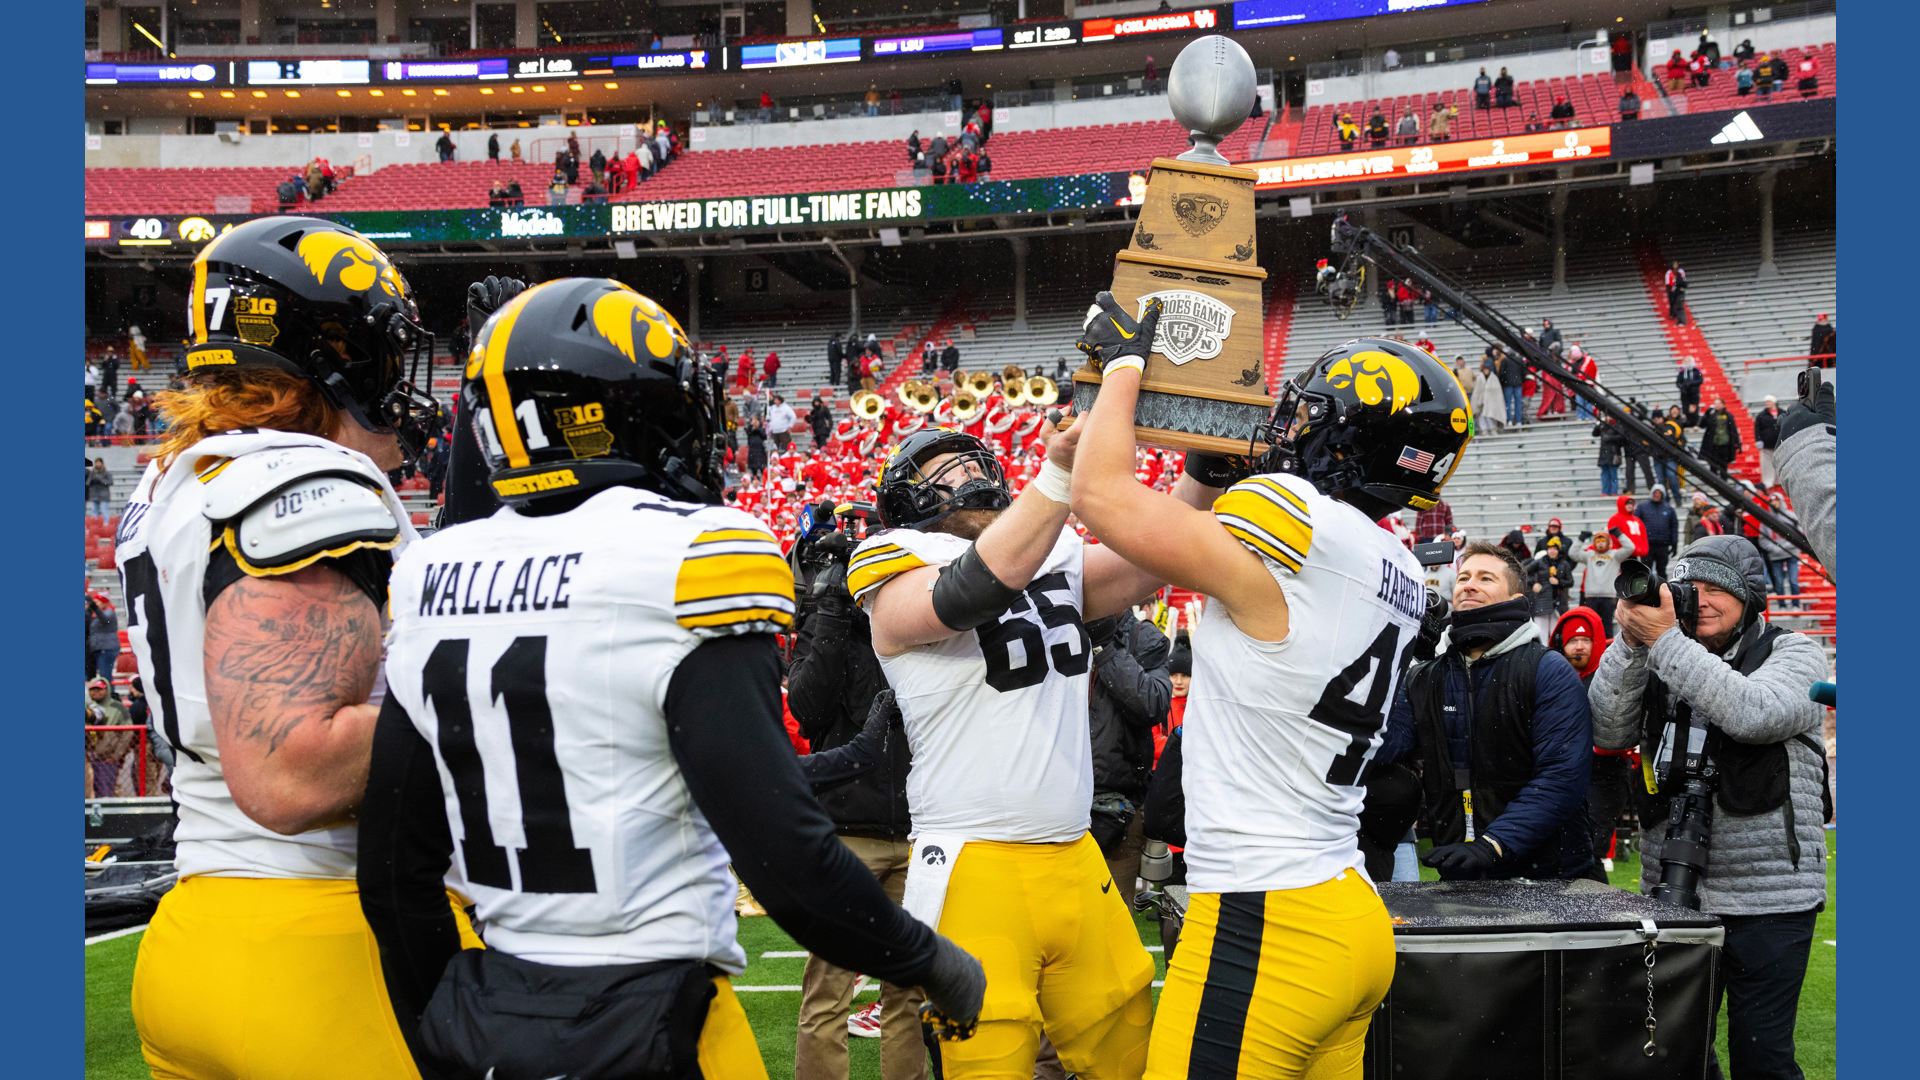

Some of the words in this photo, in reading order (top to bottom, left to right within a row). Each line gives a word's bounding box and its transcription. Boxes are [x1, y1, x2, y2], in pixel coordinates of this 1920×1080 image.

[1123, 16, 1190, 34] OKLAHOMA
[901, 39, 924, 52] LSU
[1014, 31, 1035, 43] SAT
[519, 61, 539, 73] SAT
[638, 55, 685, 69] ILLINOIS
[1492, 139, 1505, 155] 2
[1564, 132, 1578, 147] 0
[1410, 147, 1433, 163] 20
[1255, 166, 1284, 185] UKE
[1283, 155, 1394, 181] LINDENMEYER
[611, 203, 702, 232] BREWED
[706, 201, 748, 228] FOR
[751, 194, 862, 226] FULL-TIME
[866, 190, 922, 219] FANS
[130, 218, 163, 240] 40
[501, 212, 564, 236] Modelo
[1193, 301, 1226, 334] GAME
[419, 552, 584, 618] WALLACE
[974, 571, 1092, 693] 65
[422, 635, 598, 895] 11
